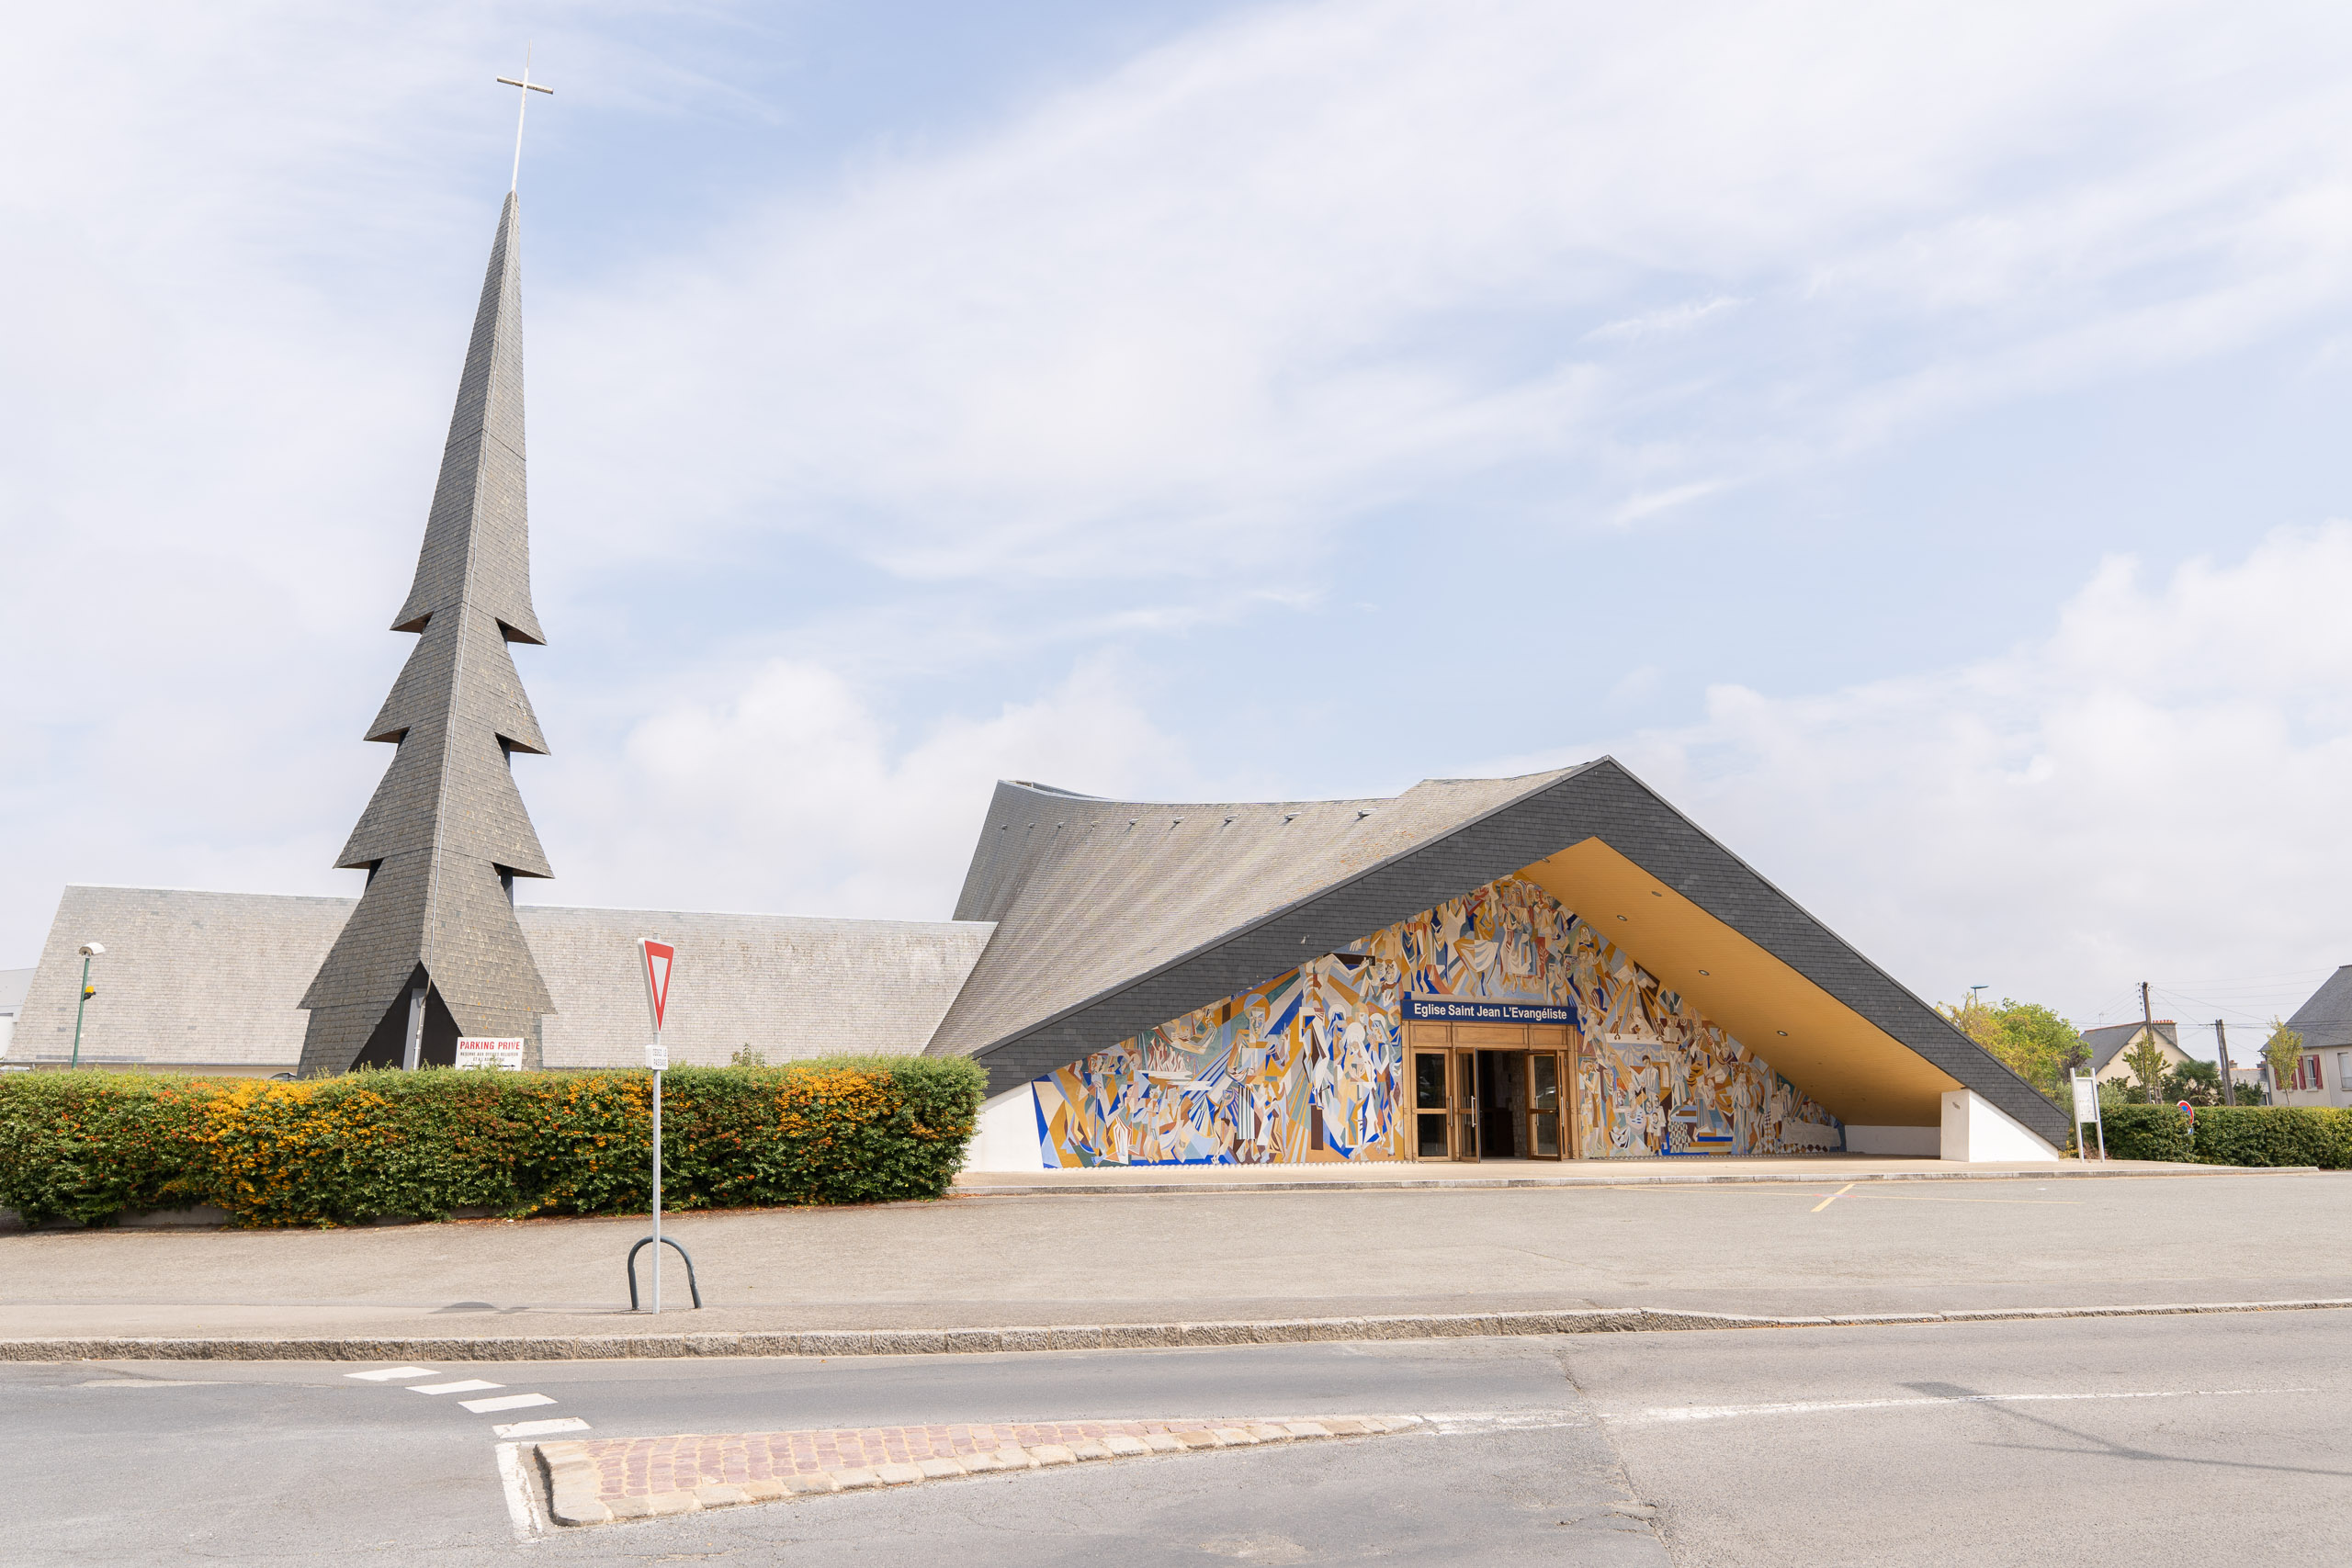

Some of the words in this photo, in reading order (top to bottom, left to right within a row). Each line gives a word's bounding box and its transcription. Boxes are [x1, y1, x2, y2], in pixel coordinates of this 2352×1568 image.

[1414, 1003, 1446, 1018] Eglise
[1448, 1004, 1475, 1017] Saint
[1476, 1005, 1500, 1018] Jean
[1503, 1006, 1567, 1021] L'Evangéliste
[459, 1041, 495, 1050] PARKING
